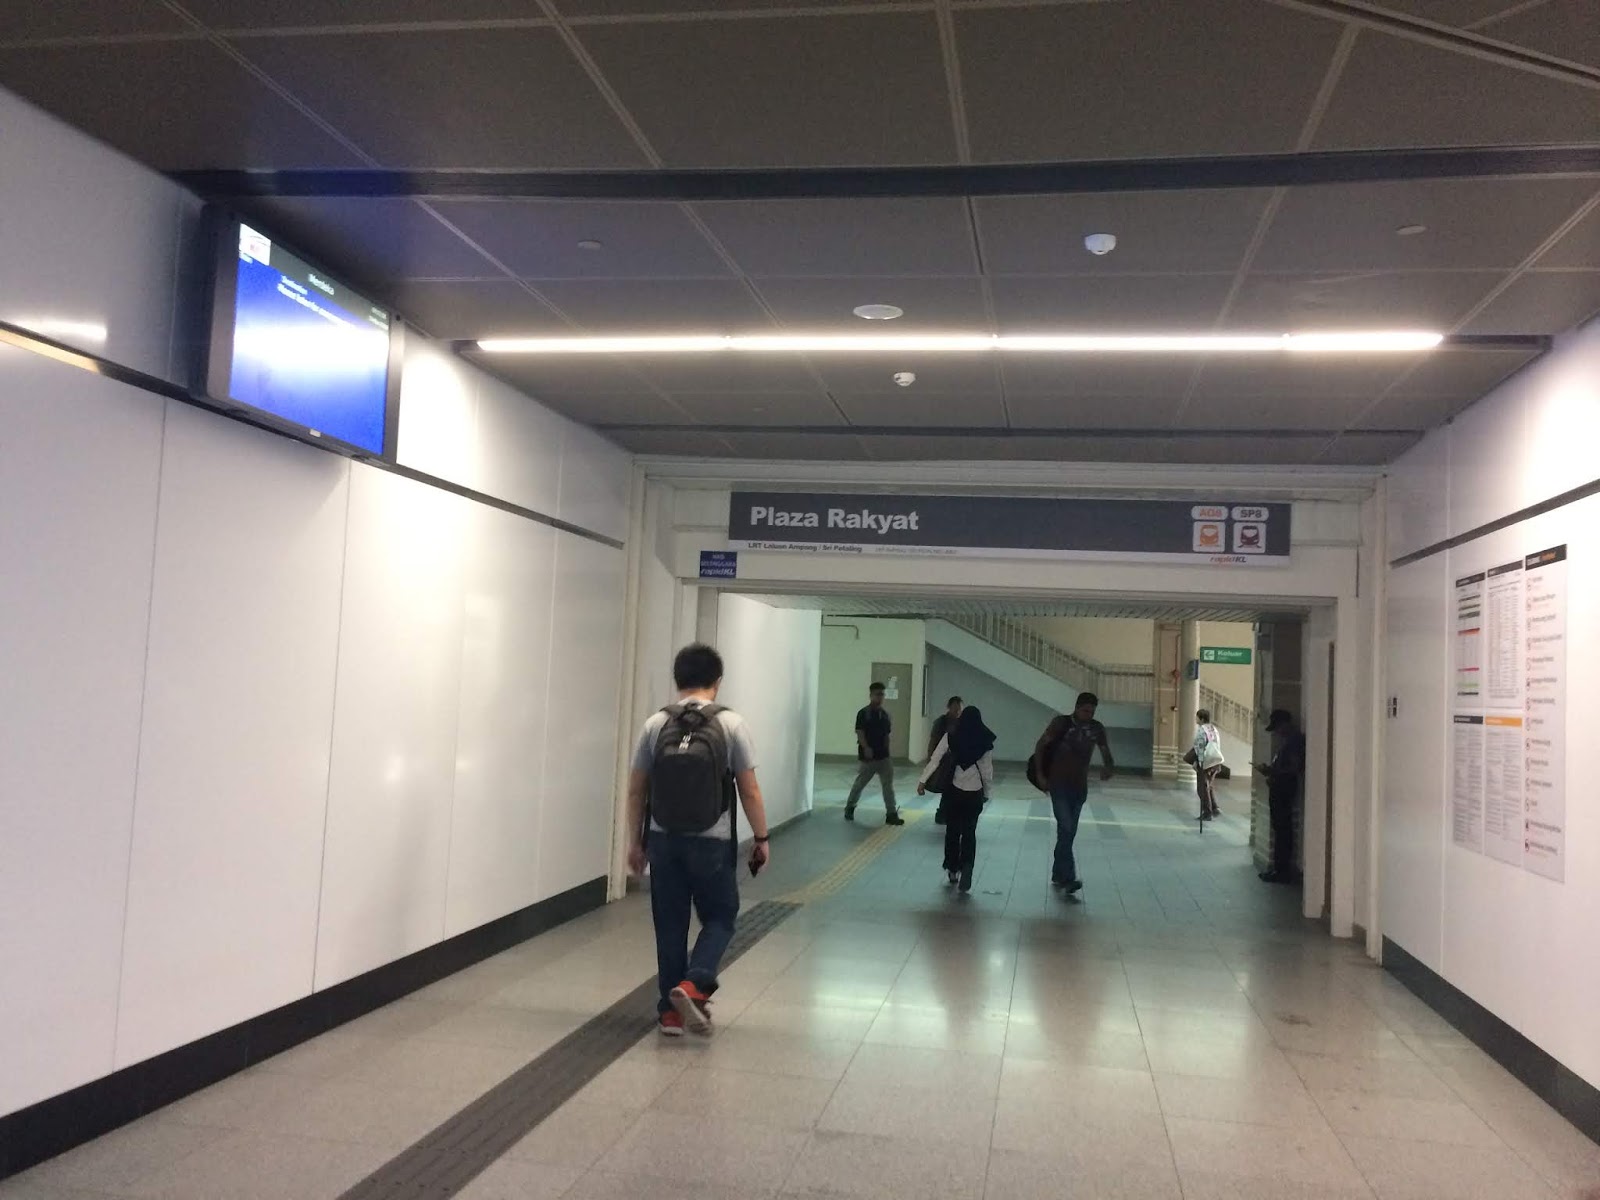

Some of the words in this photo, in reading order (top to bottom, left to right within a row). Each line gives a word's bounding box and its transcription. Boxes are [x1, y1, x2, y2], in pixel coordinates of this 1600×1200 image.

[750, 506, 819, 528] Plaza
[827, 508, 919, 534] Rakyat
[1240, 509, 1262, 518] SP8
